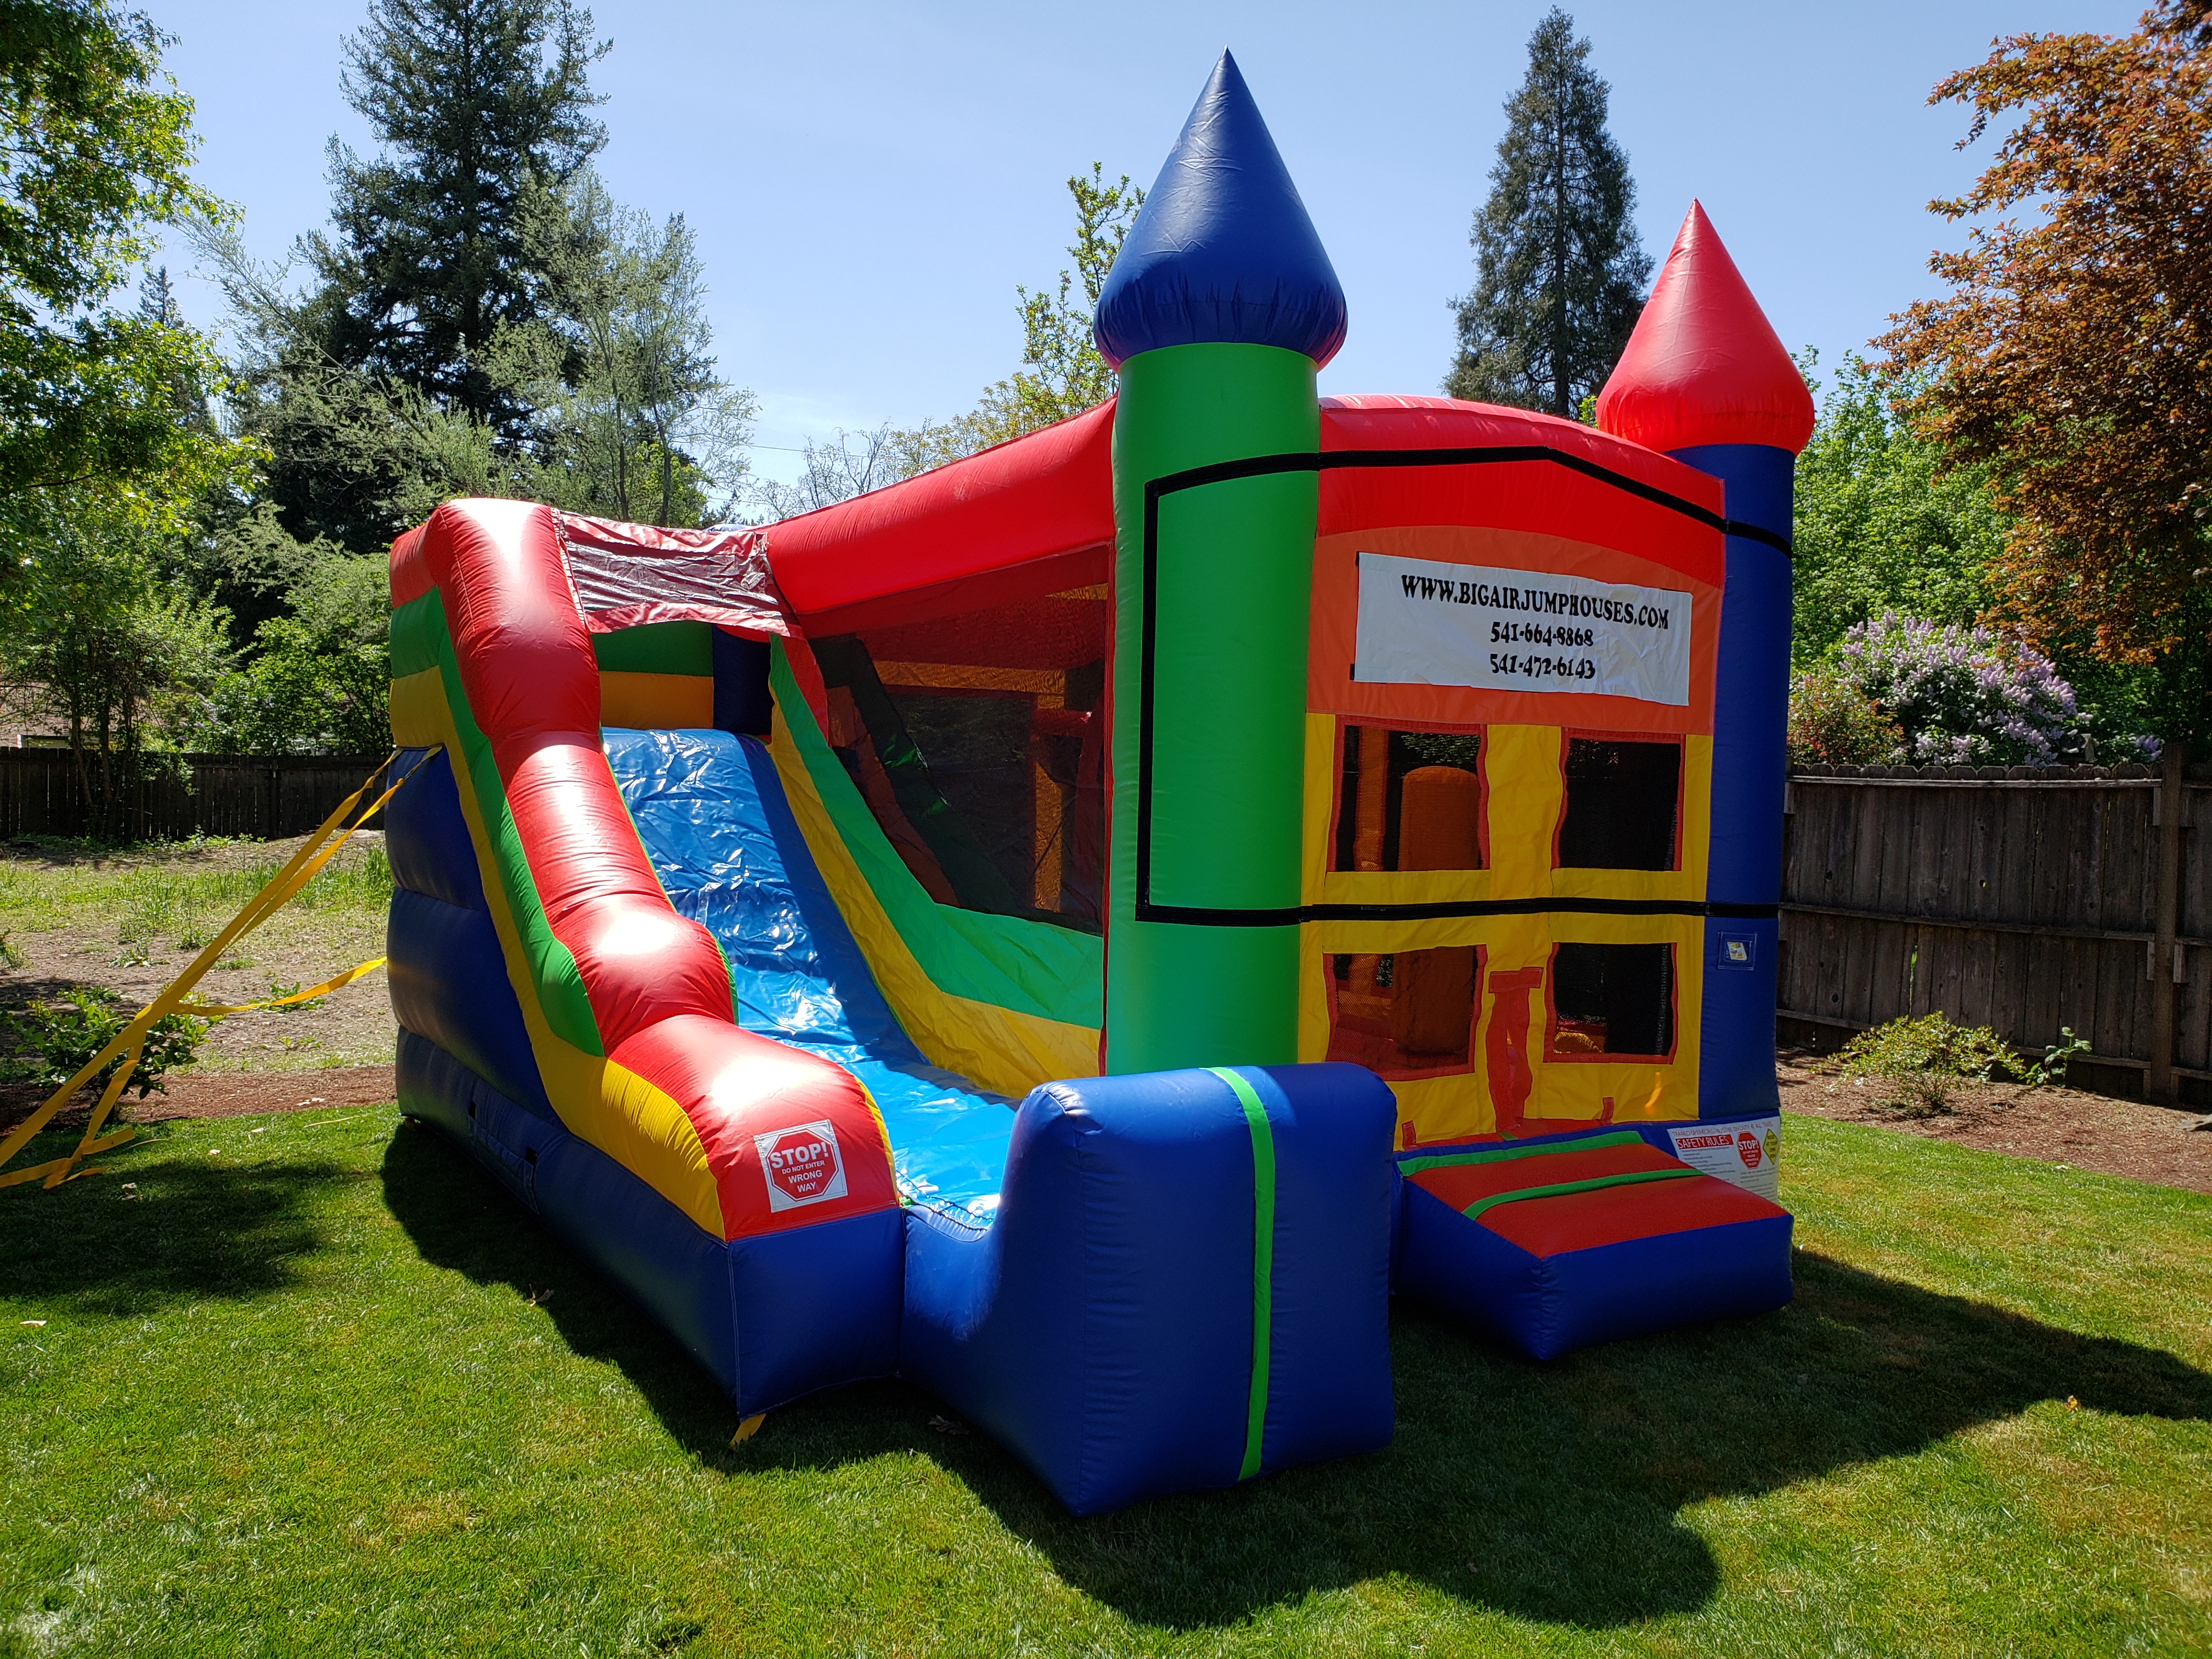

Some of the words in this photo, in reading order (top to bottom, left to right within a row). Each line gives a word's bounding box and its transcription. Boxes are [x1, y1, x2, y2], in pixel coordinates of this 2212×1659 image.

[1401, 574, 1669, 629] WWW.BIGAIRJUMPHOUSES.COM
[1491, 622, 1594, 646] 541-664-8868
[1489, 653, 1595, 679] 541-472-6143
[1677, 1137, 1705, 1149] SAFETY
[1705, 1136, 1729, 1146] RULES
[1738, 1139, 1759, 1150] STOP!
[770, 1142, 829, 1169] STOP!
[805, 1160, 825, 1169] ENTER
[788, 1170, 822, 1184] WRONG
[797, 1182, 816, 1193] WAY
